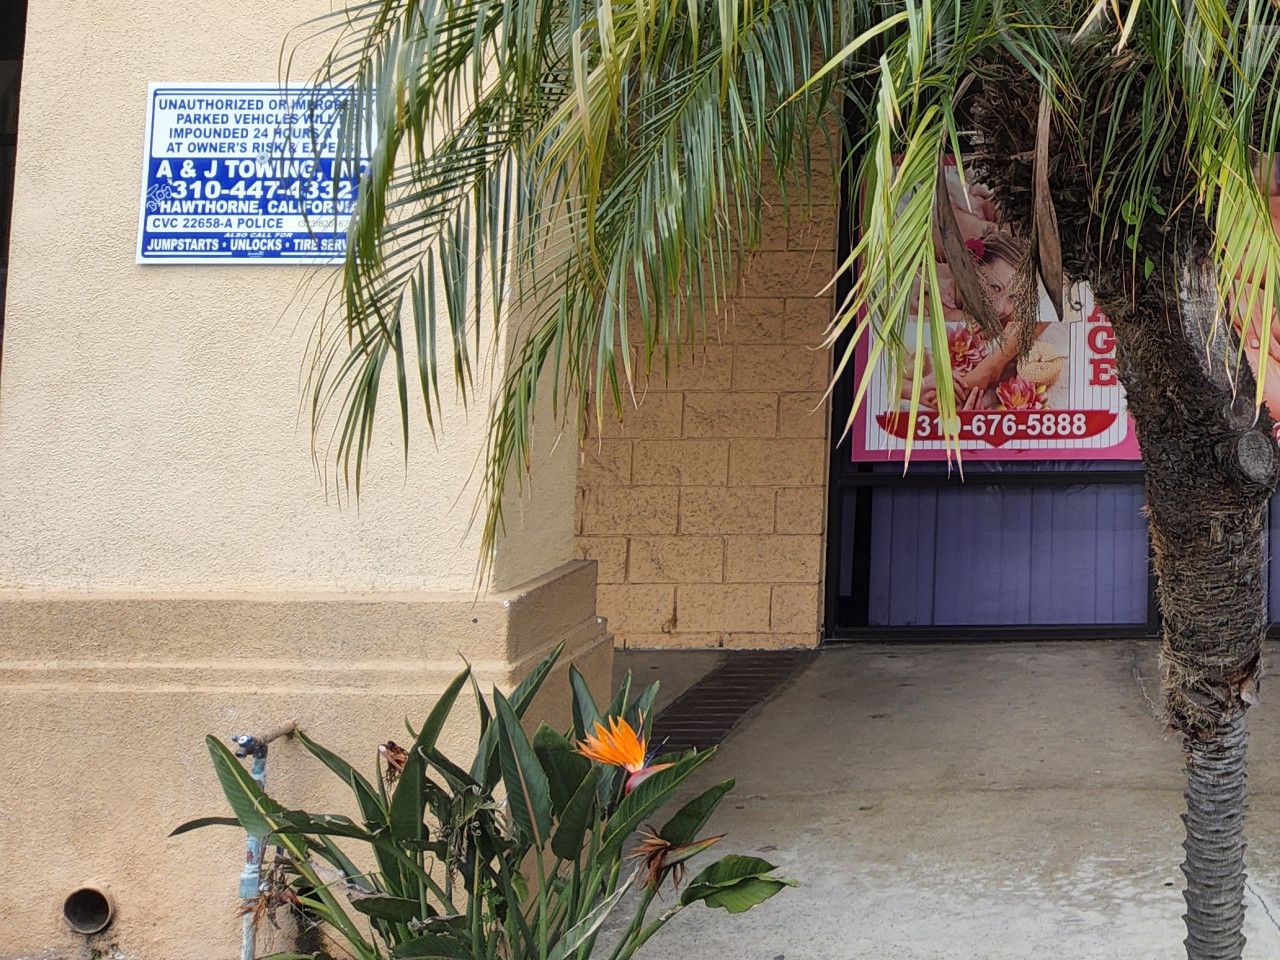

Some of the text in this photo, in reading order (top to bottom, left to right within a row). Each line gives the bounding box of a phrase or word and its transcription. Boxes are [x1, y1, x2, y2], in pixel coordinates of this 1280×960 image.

[158, 99, 264, 110] UNAUTHORIZED
[268, 99, 287, 110] OR
[176, 114, 229, 124] PARKED
[234, 114, 299, 124] VEHICLES
[169, 128, 249, 138] IMPOUNDED
[253, 128, 269, 138] 24
[274, 128, 320, 138] HOURS
[166, 142, 183, 153] AT
[187, 142, 248, 153] OWNER'S
[252, 142, 284, 153] RISK
[155, 160, 173, 178] A
[180, 160, 197, 178] &
[203, 160, 219, 178] J
[171, 180, 353, 199] 310-447-4332
[160, 200, 263, 215] HAWTHORNE,
[153, 218, 178, 229] CVC
[183, 218, 233, 229] 22658-A
[237, 218, 284, 229] POLICE
[146, 238, 219, 251] JUMPSTARTS
[230, 238, 282, 251] UNLOCKS
[917, 414, 1087, 437] 310-676-5888
